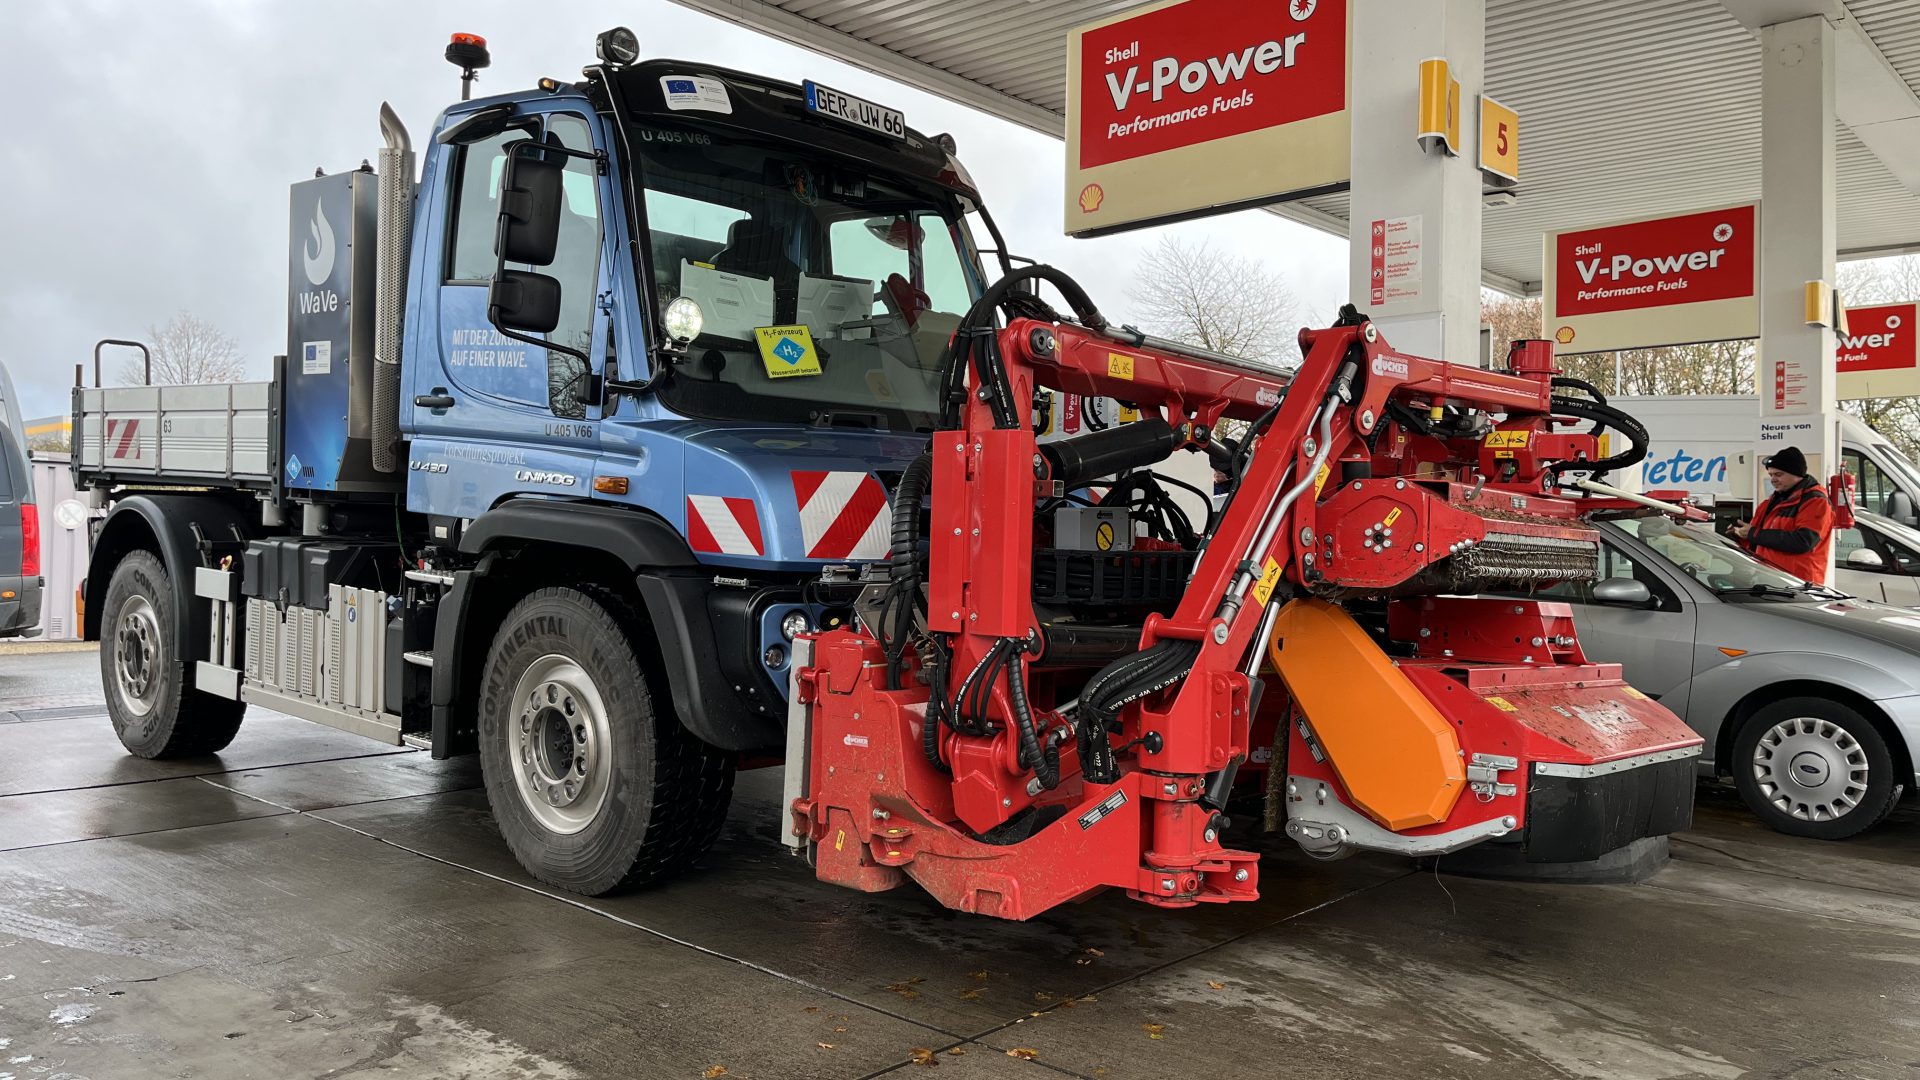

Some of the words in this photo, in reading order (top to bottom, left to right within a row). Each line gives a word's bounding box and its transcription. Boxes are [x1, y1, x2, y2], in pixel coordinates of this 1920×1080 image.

[1105, 41, 1139, 64] Shell
[1105, 32, 1305, 112] V-Power
[816, 88, 849, 119] GER
[859, 103, 879, 128] UW
[883, 112, 902, 135] 66
[1107, 104, 1208, 139] Performance
[1212, 89, 1254, 113] Fuels
[641, 130, 653, 142] U
[657, 131, 682, 143] 405
[684, 132, 711, 145] V66
[1496, 122, 1508, 156] 5
[1575, 243, 1601, 256] Shell
[1575, 248, 1725, 284] V-Power
[1577, 284, 1654, 300] Performance
[1657, 278, 1688, 291] Fuels
[299, 290, 338, 314] WaVe
[452, 329, 469, 345] MIT
[470, 330, 489, 346] DER
[451, 350, 469, 366] AUF
[469, 351, 495, 366] EINER
[497, 351, 528, 368] WAVE.
[1844, 352, 1868, 362] Fuels
[163, 419, 172, 434] 63
[545, 423, 552, 437] U
[554, 424, 571, 437] 405
[573, 425, 592, 438] V66
[1761, 423, 1791, 431] Neues
[1761, 432, 1783, 440] Shell
[1642, 448, 1726, 485] ieten
[515, 470, 576, 487] UNIMOG
[484, 616, 567, 736] CONTINENTAL
